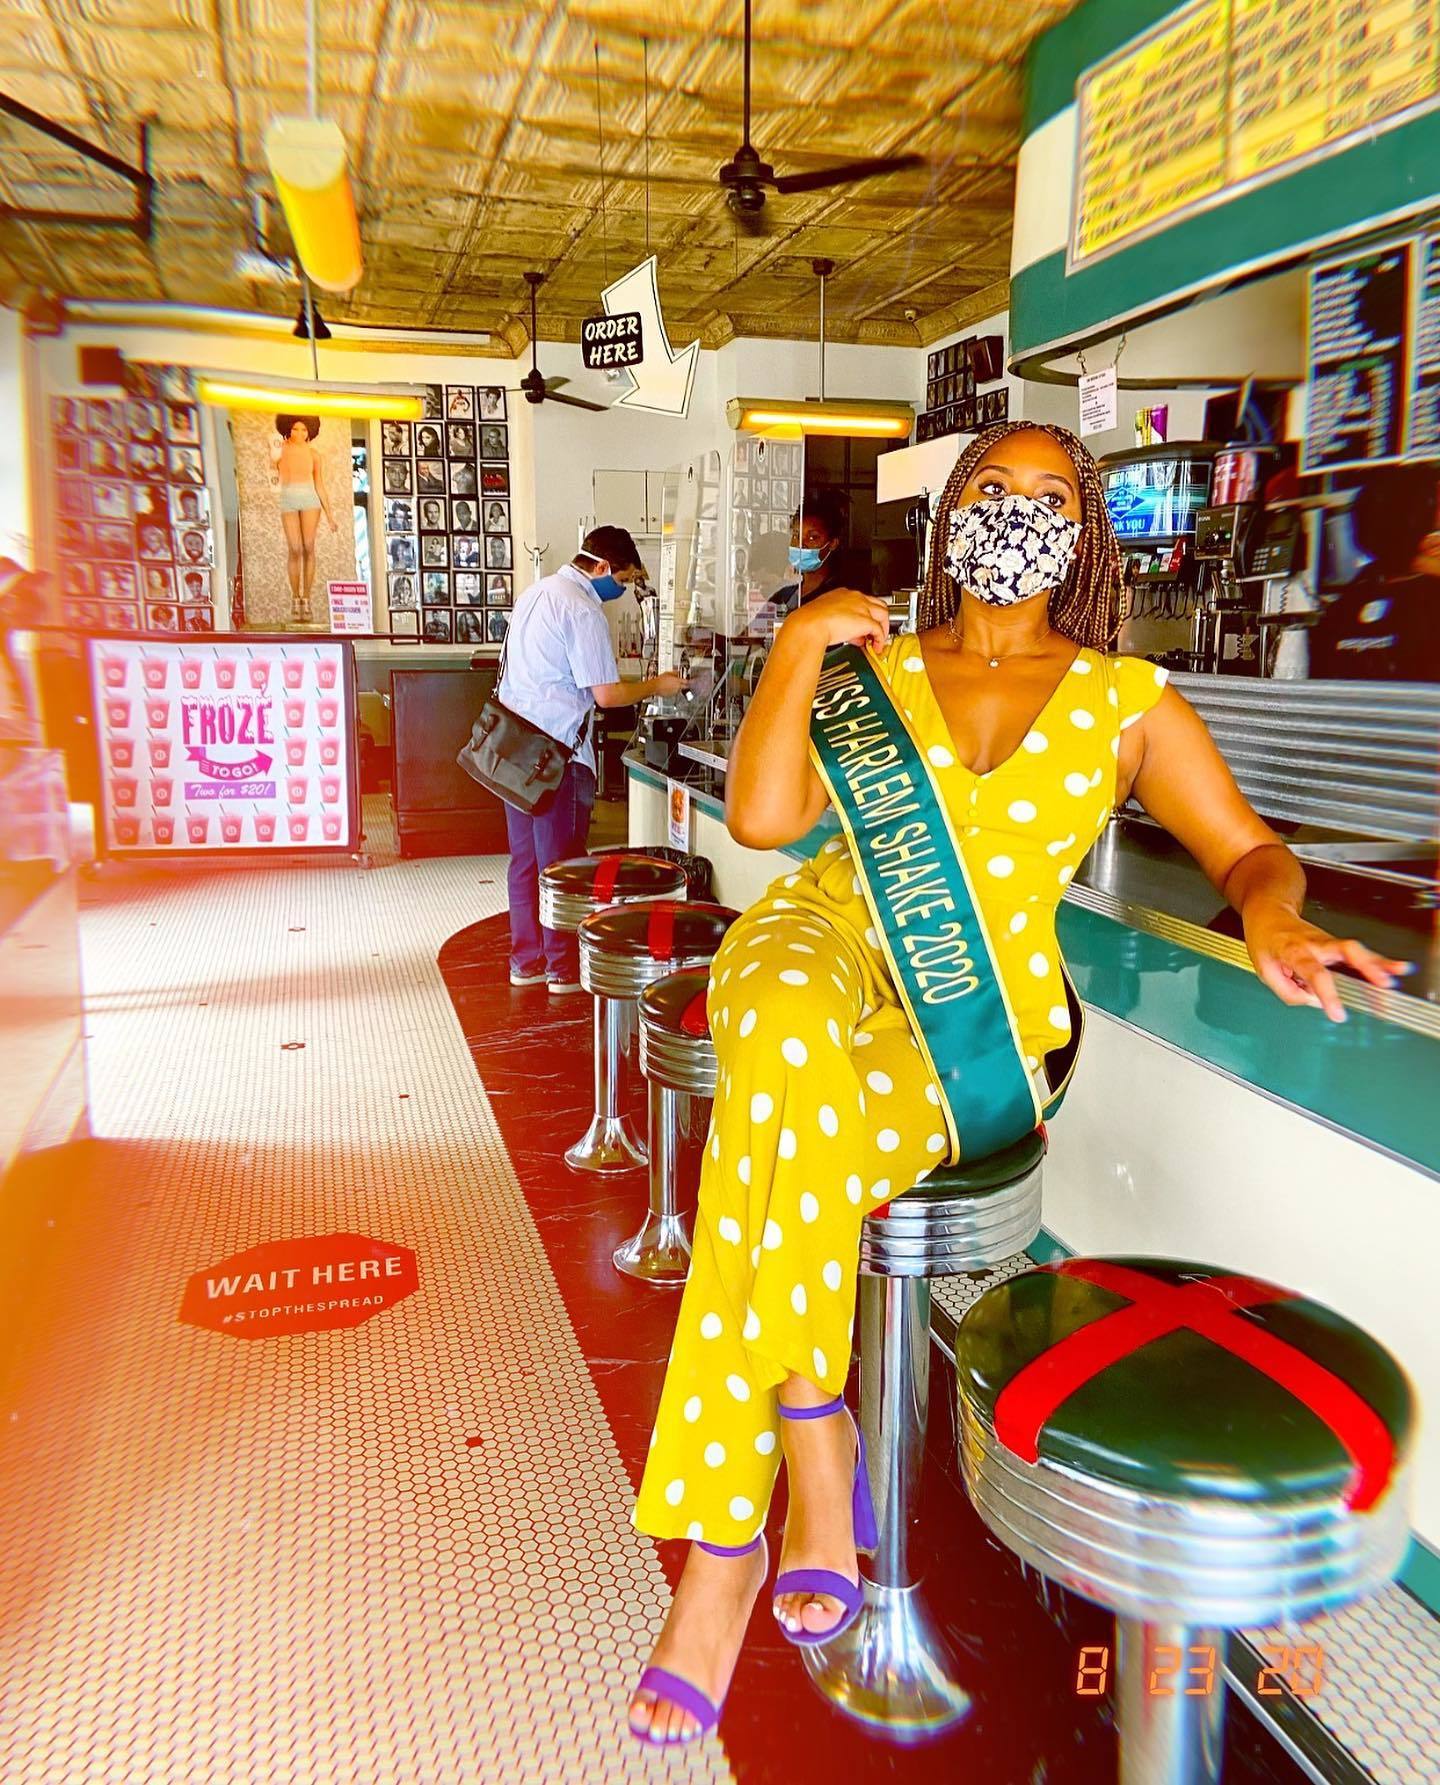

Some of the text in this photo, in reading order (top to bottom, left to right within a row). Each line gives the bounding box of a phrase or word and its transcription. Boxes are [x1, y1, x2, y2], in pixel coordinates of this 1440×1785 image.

[585, 316, 639, 341] ORDER
[589, 341, 638, 366] HERE
[1126, 519, 1145, 530] YOU
[212, 762, 259, 777] TO GO!
[823, 711, 920, 830] HARLEM
[191, 784, 271, 799] Two for $20!
[869, 822, 956, 927] SHAKE
[902, 921, 979, 1005] 2020
[207, 1257, 402, 1299] WAIT HERE
[222, 1295, 384, 1324] #STOPTHESPREAD
